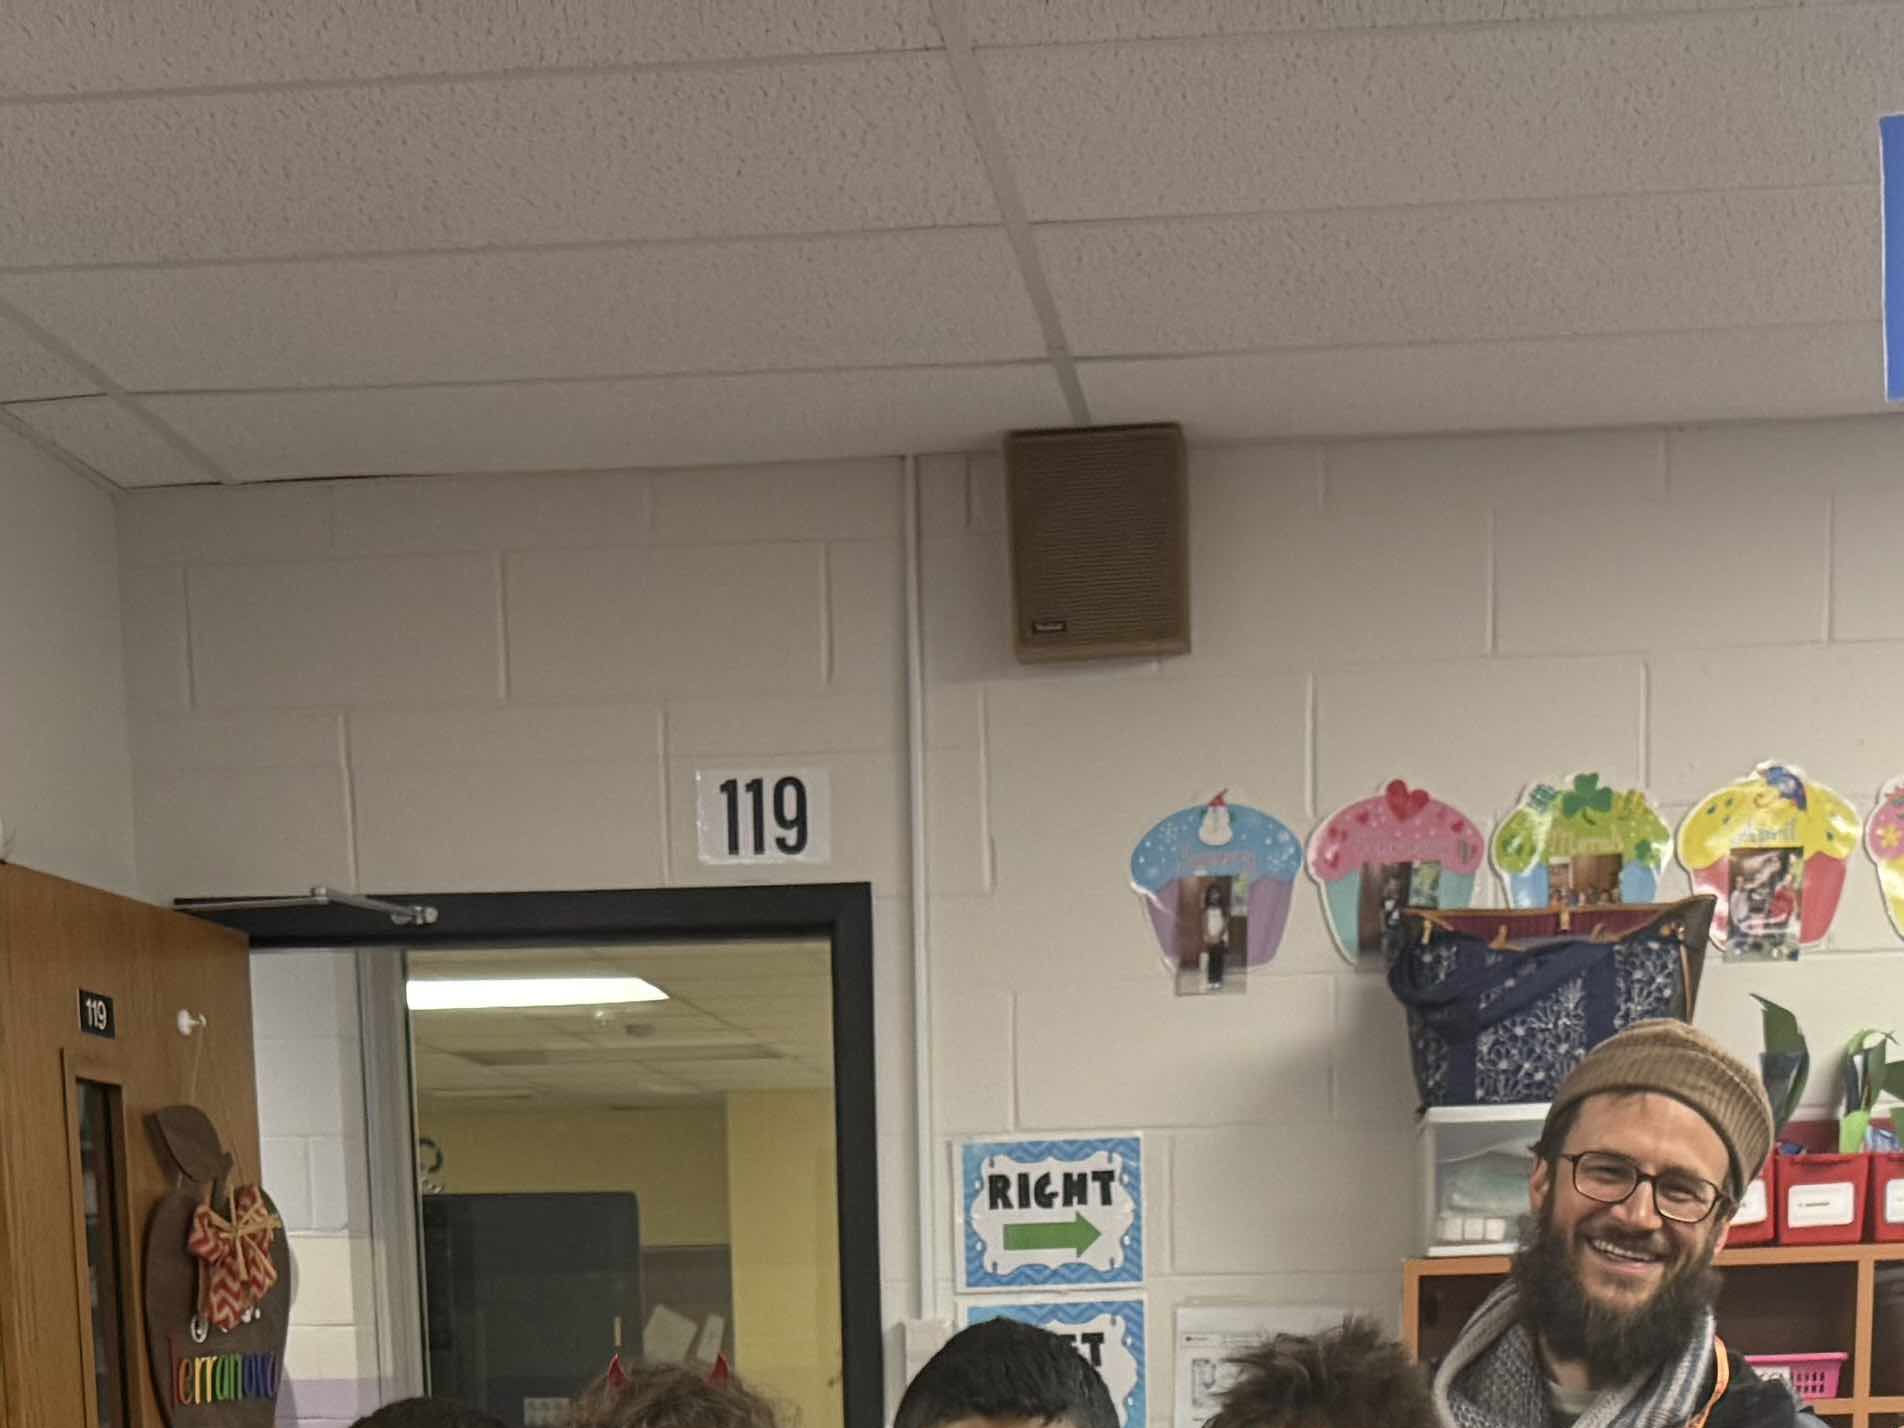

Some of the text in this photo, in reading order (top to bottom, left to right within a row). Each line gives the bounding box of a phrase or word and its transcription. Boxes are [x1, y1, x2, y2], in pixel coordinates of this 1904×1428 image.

[720, 776, 807, 855] 119
[86, 997, 106, 1030] 119
[988, 1170, 1116, 1209] RIGHT
